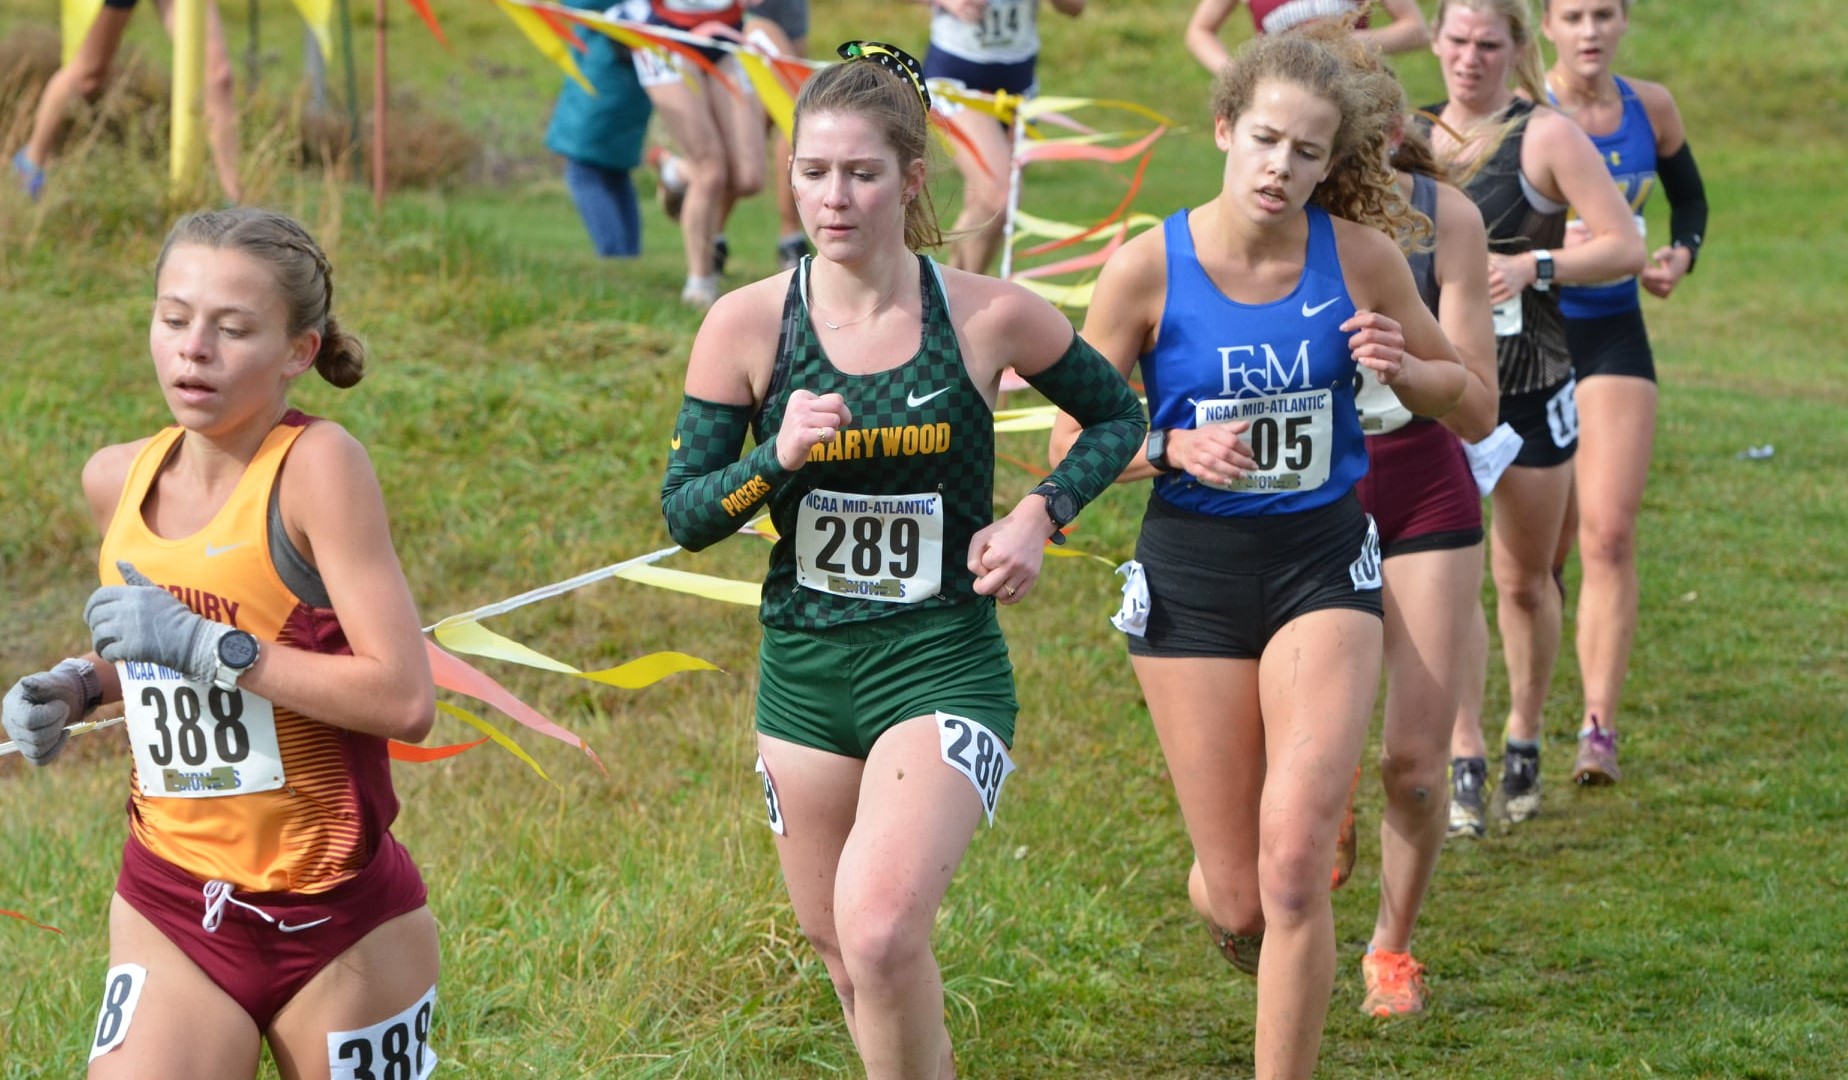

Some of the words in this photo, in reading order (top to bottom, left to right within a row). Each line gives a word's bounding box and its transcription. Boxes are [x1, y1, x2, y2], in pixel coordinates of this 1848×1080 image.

[1206, 404, 1238, 421] NCAA
[1242, 393, 1325, 416] MID-ATLANTIC
[1251, 415, 1313, 471] 05
[720, 474, 771, 517] PACERS
[806, 493, 838, 513] NCAA
[842, 499, 934, 515] MID-ATLANTIC
[815, 516, 920, 579] 289
[141, 686, 250, 766] 388
[944, 719, 1004, 812] 289
[96, 973, 132, 1048] 8
[338, 1001, 431, 1080] 388
